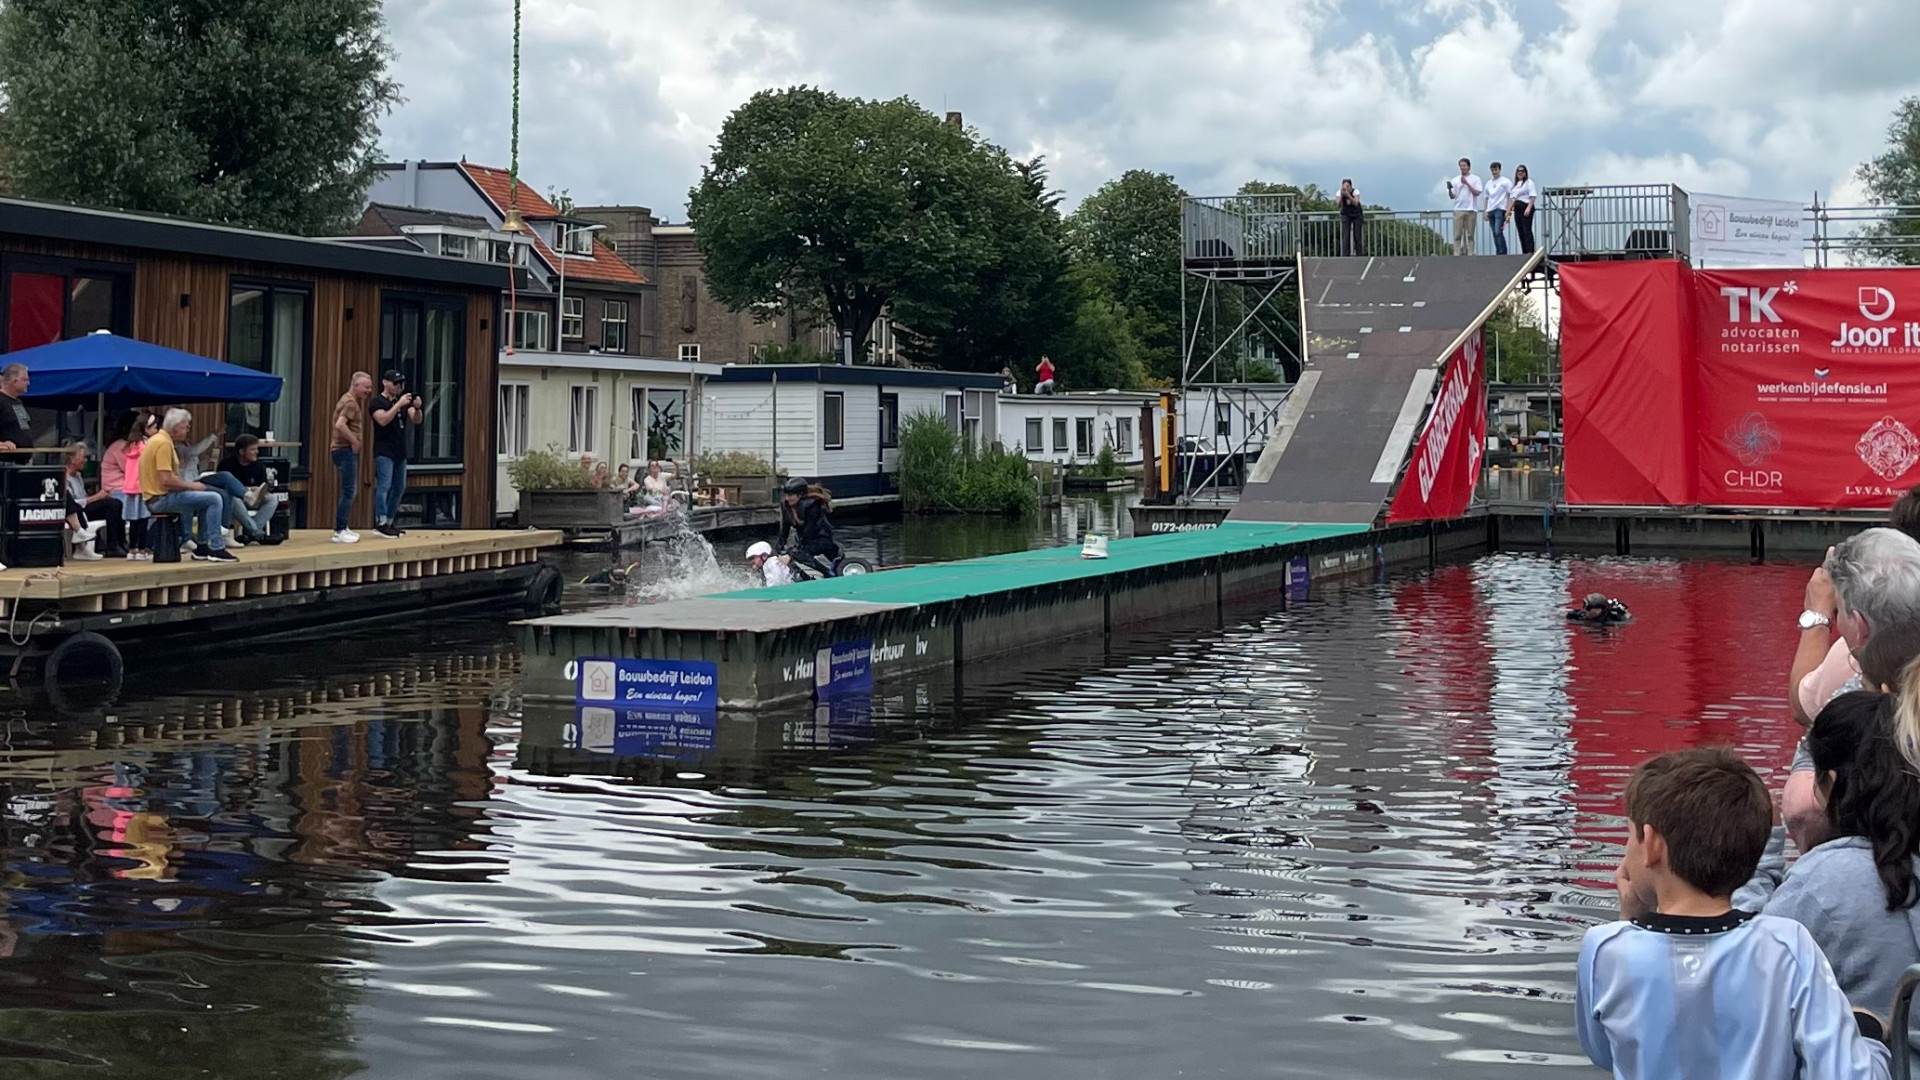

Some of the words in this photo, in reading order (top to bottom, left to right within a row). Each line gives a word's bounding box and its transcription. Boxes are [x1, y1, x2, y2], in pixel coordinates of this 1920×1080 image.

[1720, 286, 1783, 323] TK
[1721, 326, 1799, 338] advocaten
[1830, 322, 1897, 347] Joor
[1904, 322, 1920, 347] it
[1721, 341, 1800, 353] notarissen
[1757, 382, 1887, 396] werkenbijdefensie.nl
[1418, 359, 1469, 503] GLIBBERBAL
[1724, 470, 1783, 487] CHDR
[1845, 486, 1883, 495] L.V.V.S.
[915, 634, 928, 656] bv
[618, 669, 678, 687] Bouwbedrijf
[680, 671, 713, 686] Leiden
[625, 688, 643, 700] Een
[674, 690, 703, 704] hoger!
